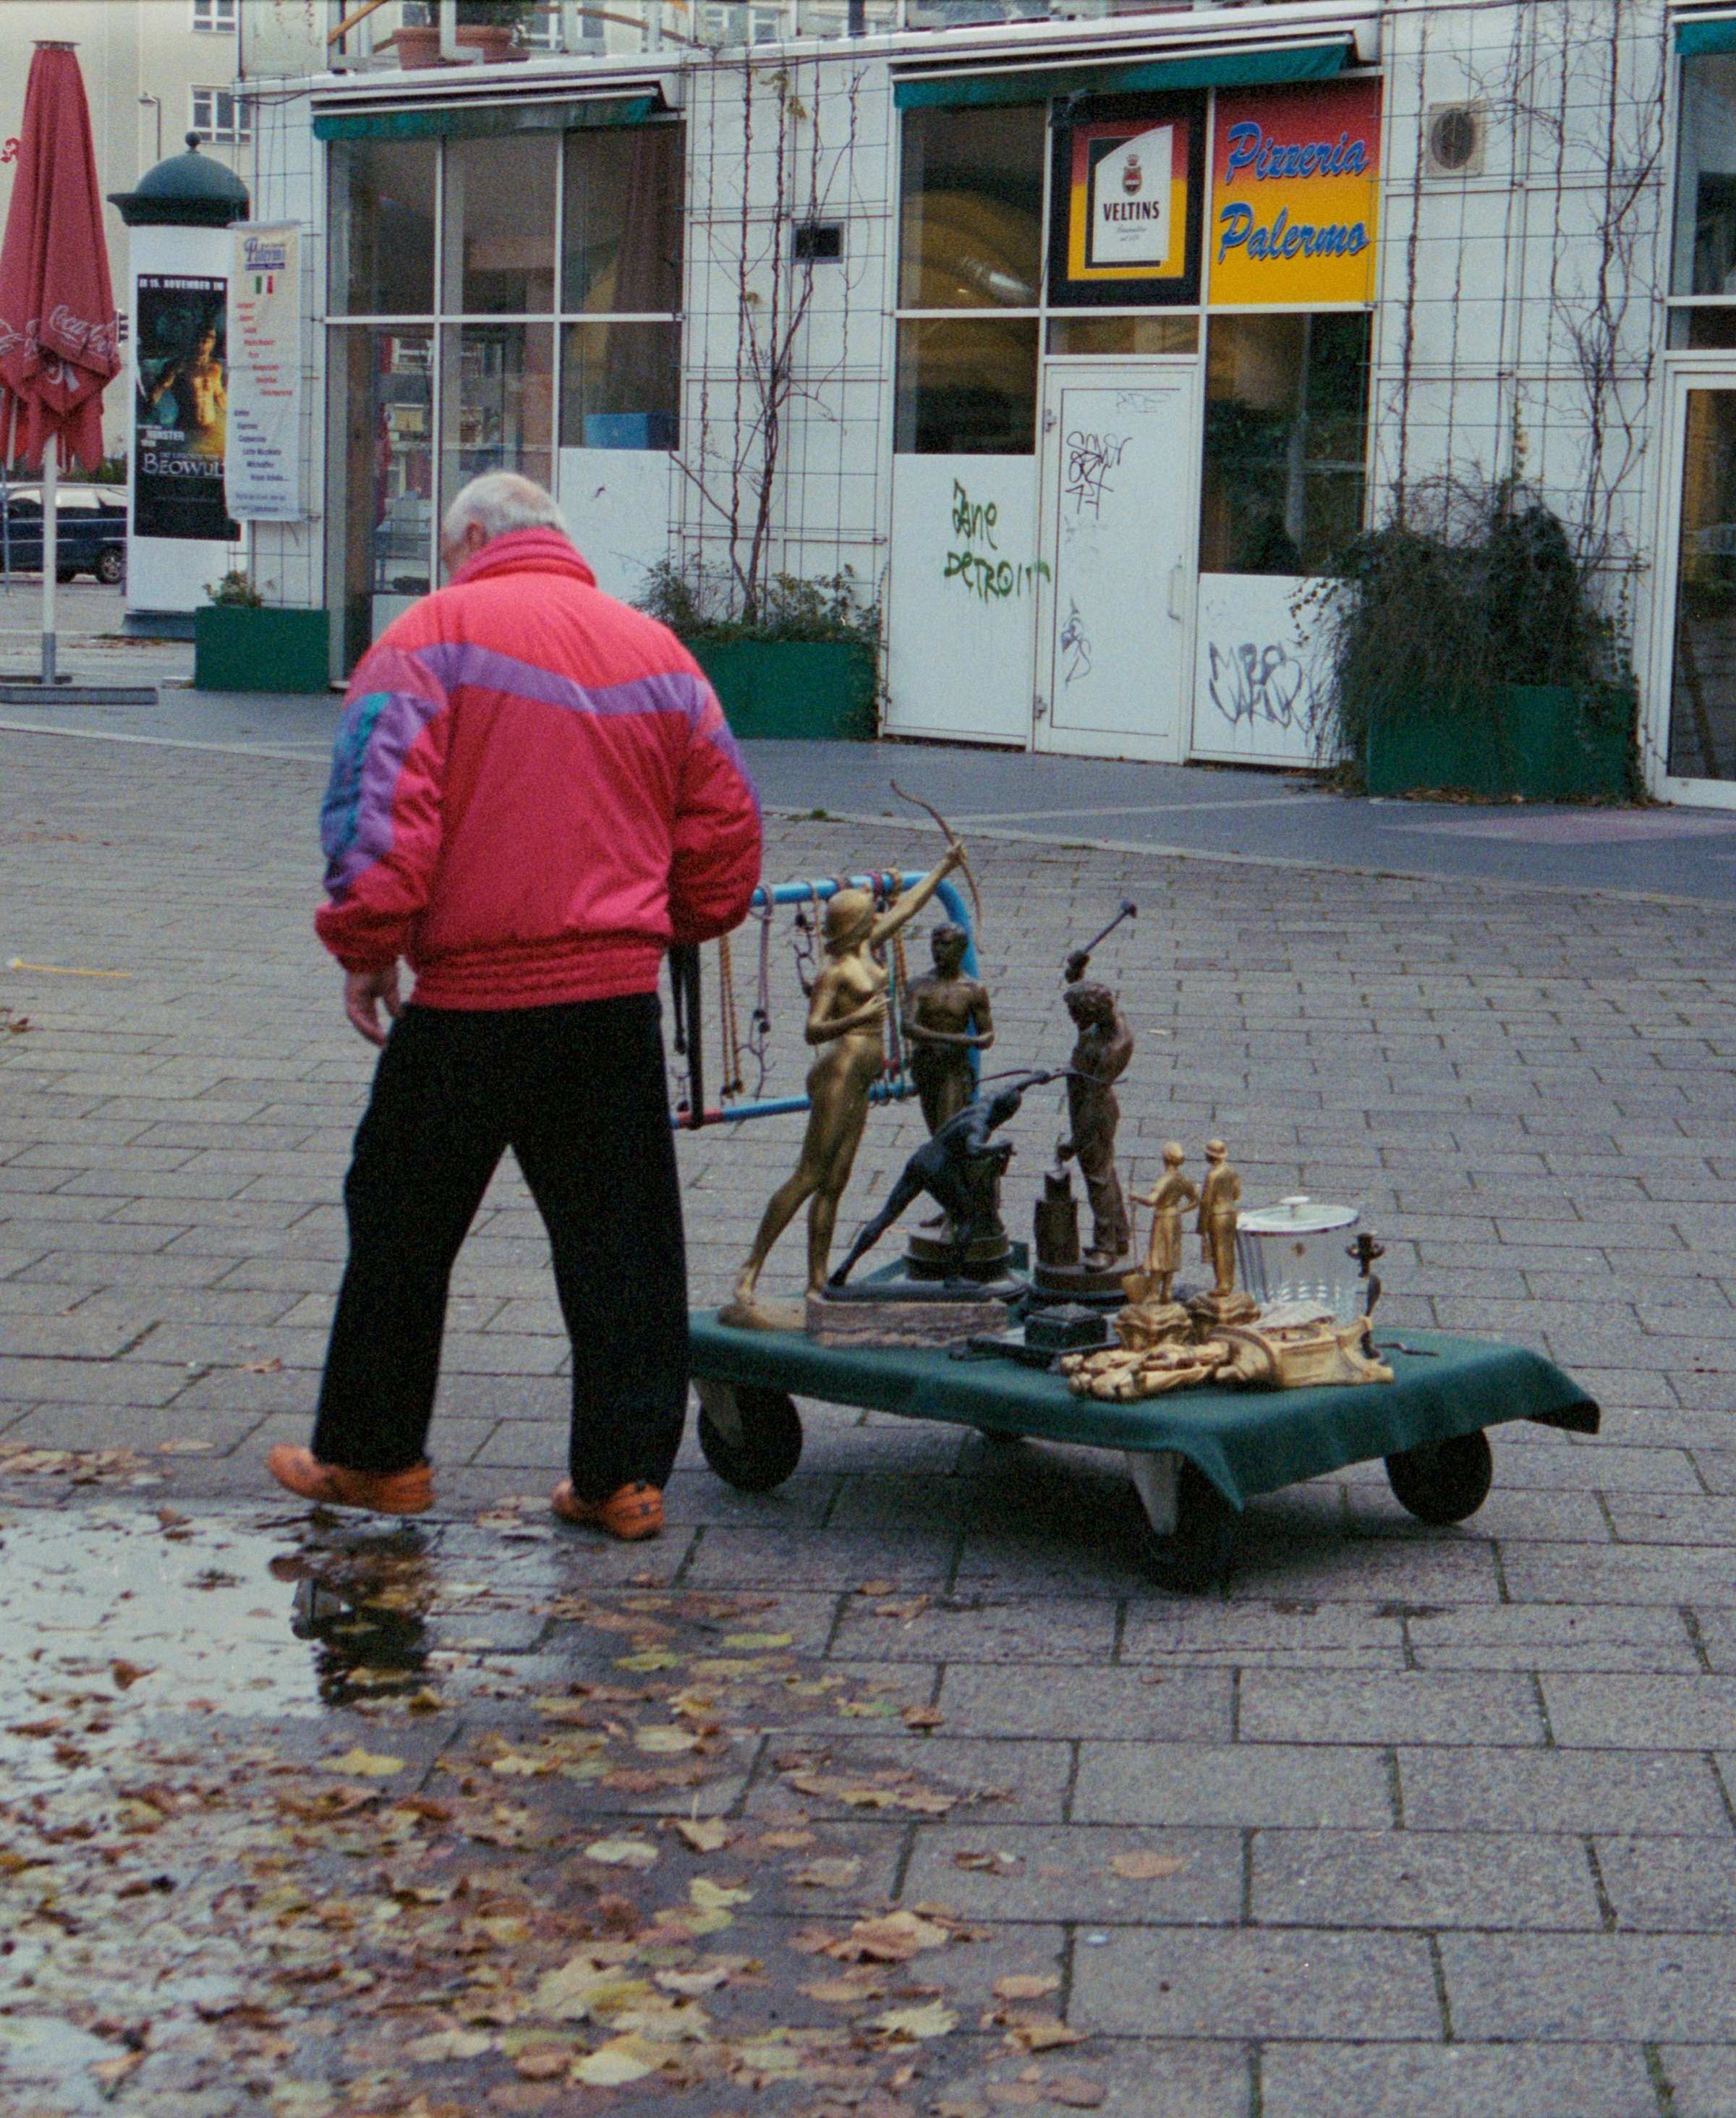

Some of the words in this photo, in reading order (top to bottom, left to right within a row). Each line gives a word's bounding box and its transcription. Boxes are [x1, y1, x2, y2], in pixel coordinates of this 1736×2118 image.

[1225, 122, 1369, 184] Pizzeria
[1103, 200, 1160, 221] VELTINS
[1218, 201, 1369, 264] Palermo
[163, 279, 210, 289] NOVEMBER
